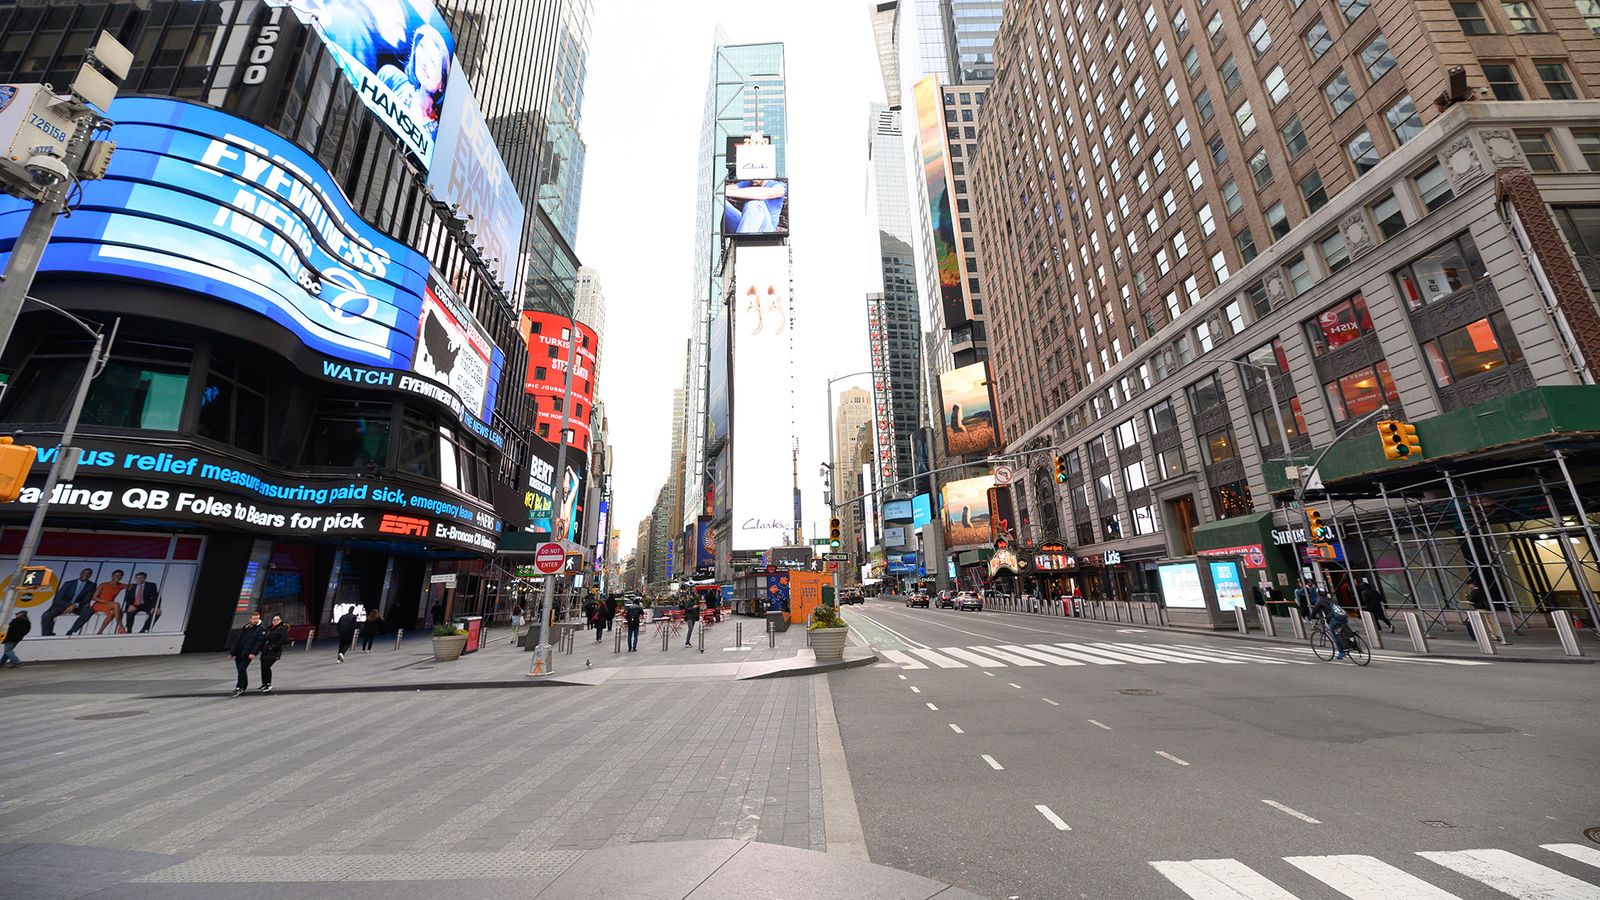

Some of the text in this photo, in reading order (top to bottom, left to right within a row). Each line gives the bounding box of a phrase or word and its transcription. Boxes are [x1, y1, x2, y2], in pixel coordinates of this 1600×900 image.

[243, 7, 281, 85] 1500
[30, 113, 67, 143] 726158
[361, 76, 429, 156] HANSEN
[461, 95, 503, 199] DEAR
[455, 124, 497, 222] EVAN
[193, 133, 391, 281] EYEWITNESS
[212, 188, 313, 276] NEWS
[297, 267, 321, 294] abc
[539, 336, 571, 349] TURKIS
[323, 361, 394, 386] WATCH
[399, 375, 451, 407] EYEWITNESS
[541, 384, 565, 394] JOURNE
[473, 420, 489, 439] NEWS
[37, 443, 115, 467] vius
[123, 451, 199, 476] relief
[330, 484, 367, 503] paid
[372, 486, 407, 506] sick,
[410, 497, 459, 518] emergency
[530, 454, 554, 485] BERT
[10, 484, 113, 511] rading
[122, 488, 169, 512] QB
[175, 492, 232, 517] Foles
[235, 502, 247, 521] to
[247, 505, 285, 528] Bears
[290, 512, 321, 529] for
[323, 512, 365, 532] pick
[379, 514, 430, 537] ESPN
[435, 523, 474, 544] Ex-Broncos
[742, 518, 785, 530] Clarks
[1271, 528, 1307, 546] SHRIM
[1104, 550, 1120, 565] Lids
